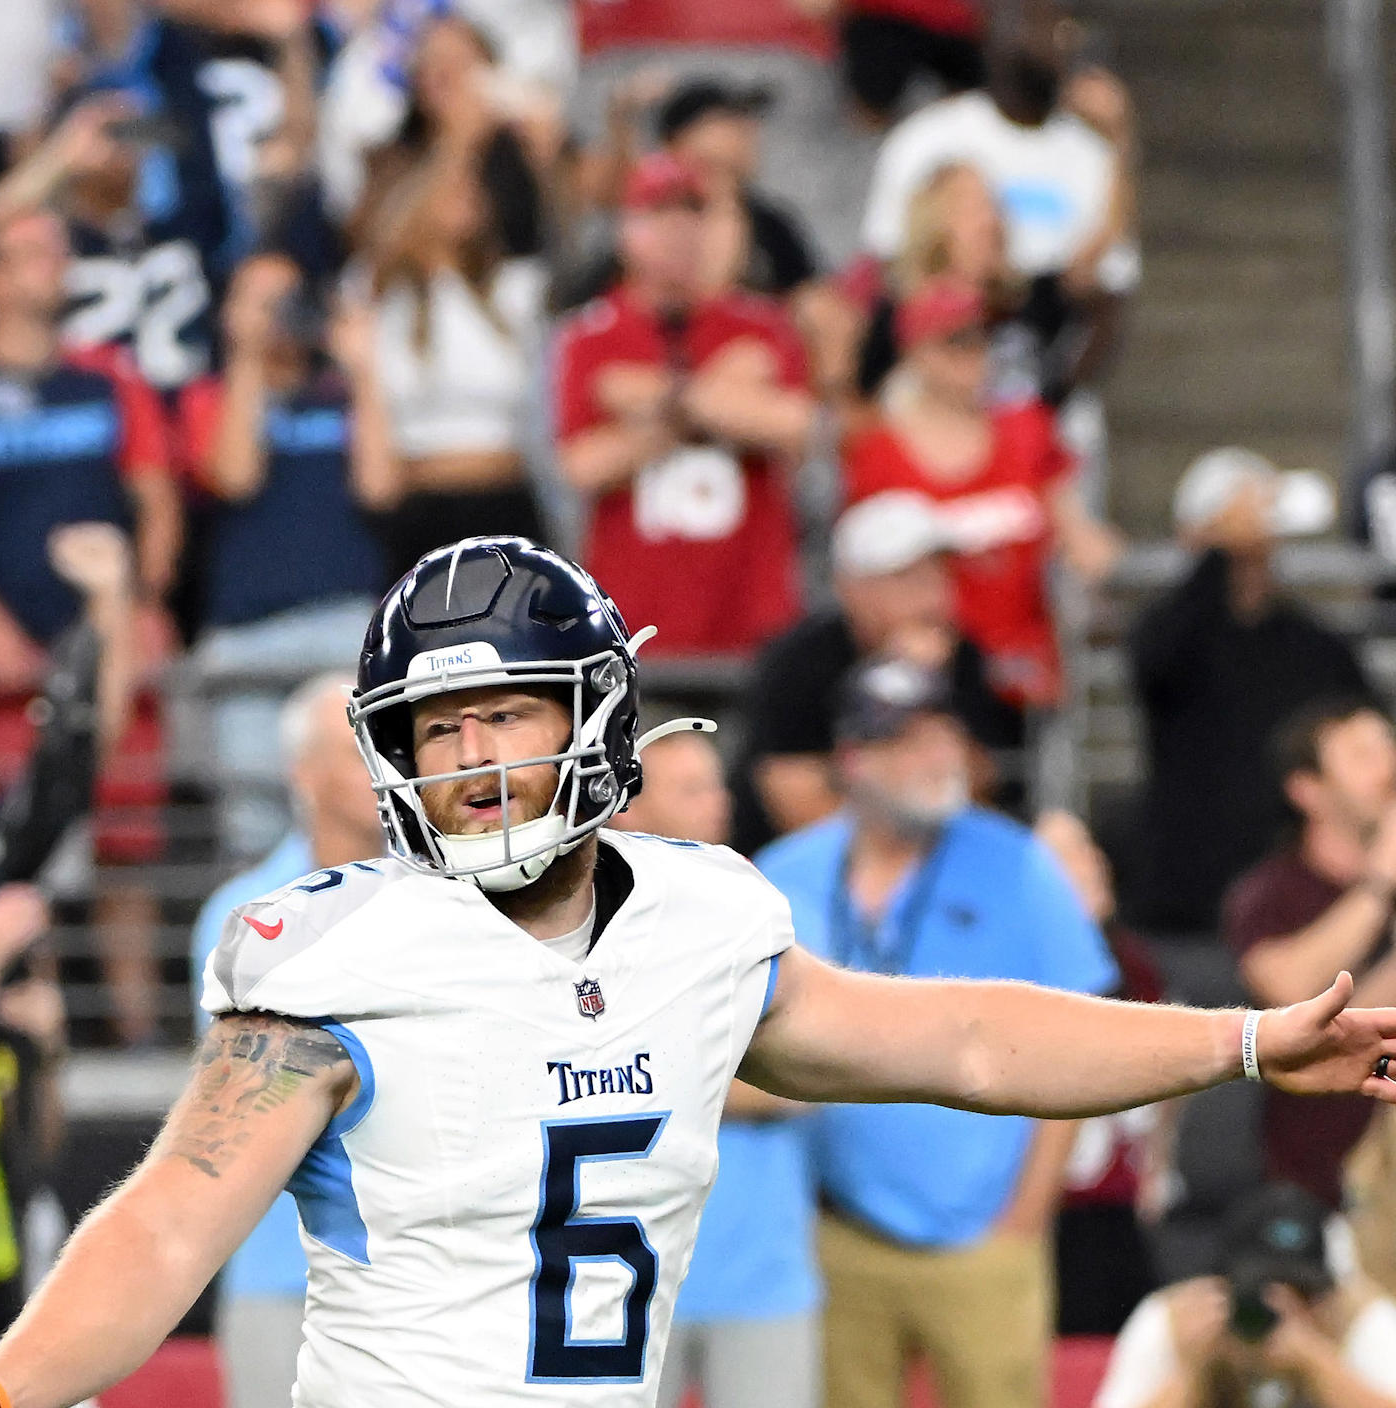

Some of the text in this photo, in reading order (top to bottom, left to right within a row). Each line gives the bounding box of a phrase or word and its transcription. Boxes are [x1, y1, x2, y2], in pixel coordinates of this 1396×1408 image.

[426, 648, 472, 671] TITANS
[581, 993, 604, 1012] NFL
[546, 1052, 654, 1106] TITANS
[525, 1110, 672, 1384] 6
